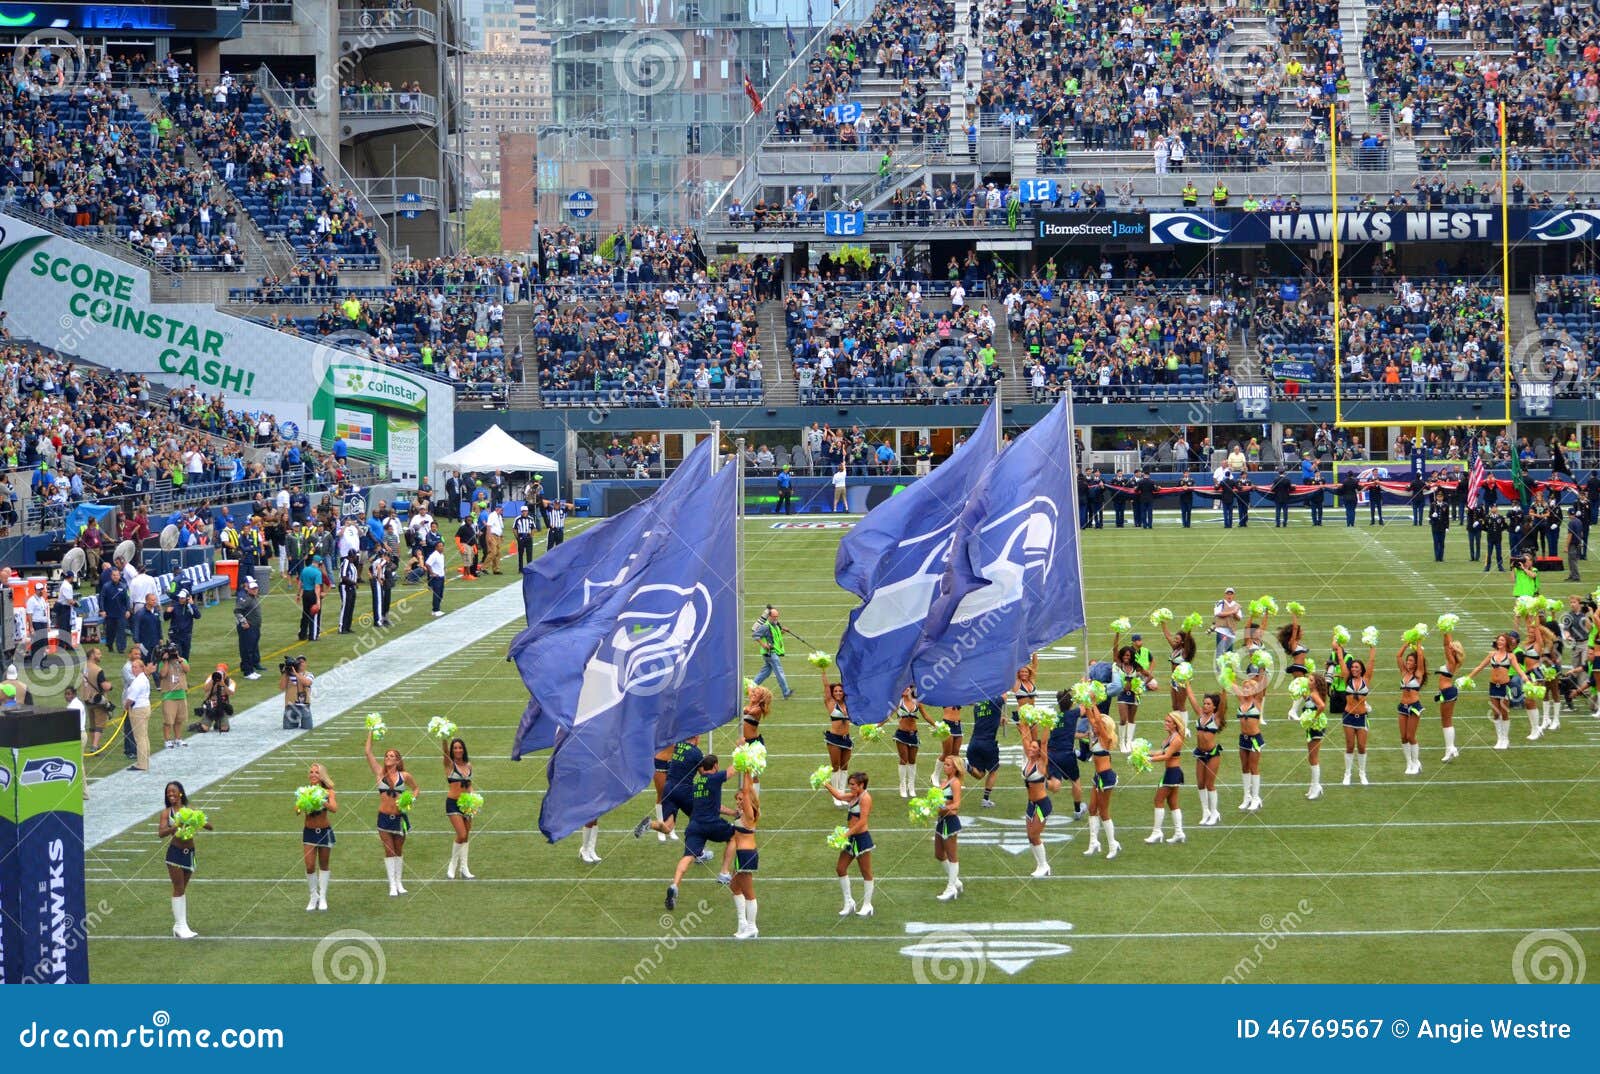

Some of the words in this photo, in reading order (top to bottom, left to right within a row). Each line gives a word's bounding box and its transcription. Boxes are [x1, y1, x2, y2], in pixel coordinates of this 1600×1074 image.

[831, 103, 856, 123] 12
[1027, 180, 1050, 200] 12
[833, 213, 856, 234] 12
[1119, 225, 1144, 234] Bank
[1269, 211, 1392, 242] HAWKS
[1406, 212, 1493, 240] NEST
[30, 251, 135, 302] SCORE
[69, 292, 225, 357] COINSTAR
[158, 348, 256, 396] CASH!
[367, 380, 417, 401] coinstar
[1237, 385, 1268, 399] VOLUME
[1521, 383, 1551, 397] VOLUME
[1240, 399, 1267, 419] 12
[1523, 396, 1550, 416] 12
